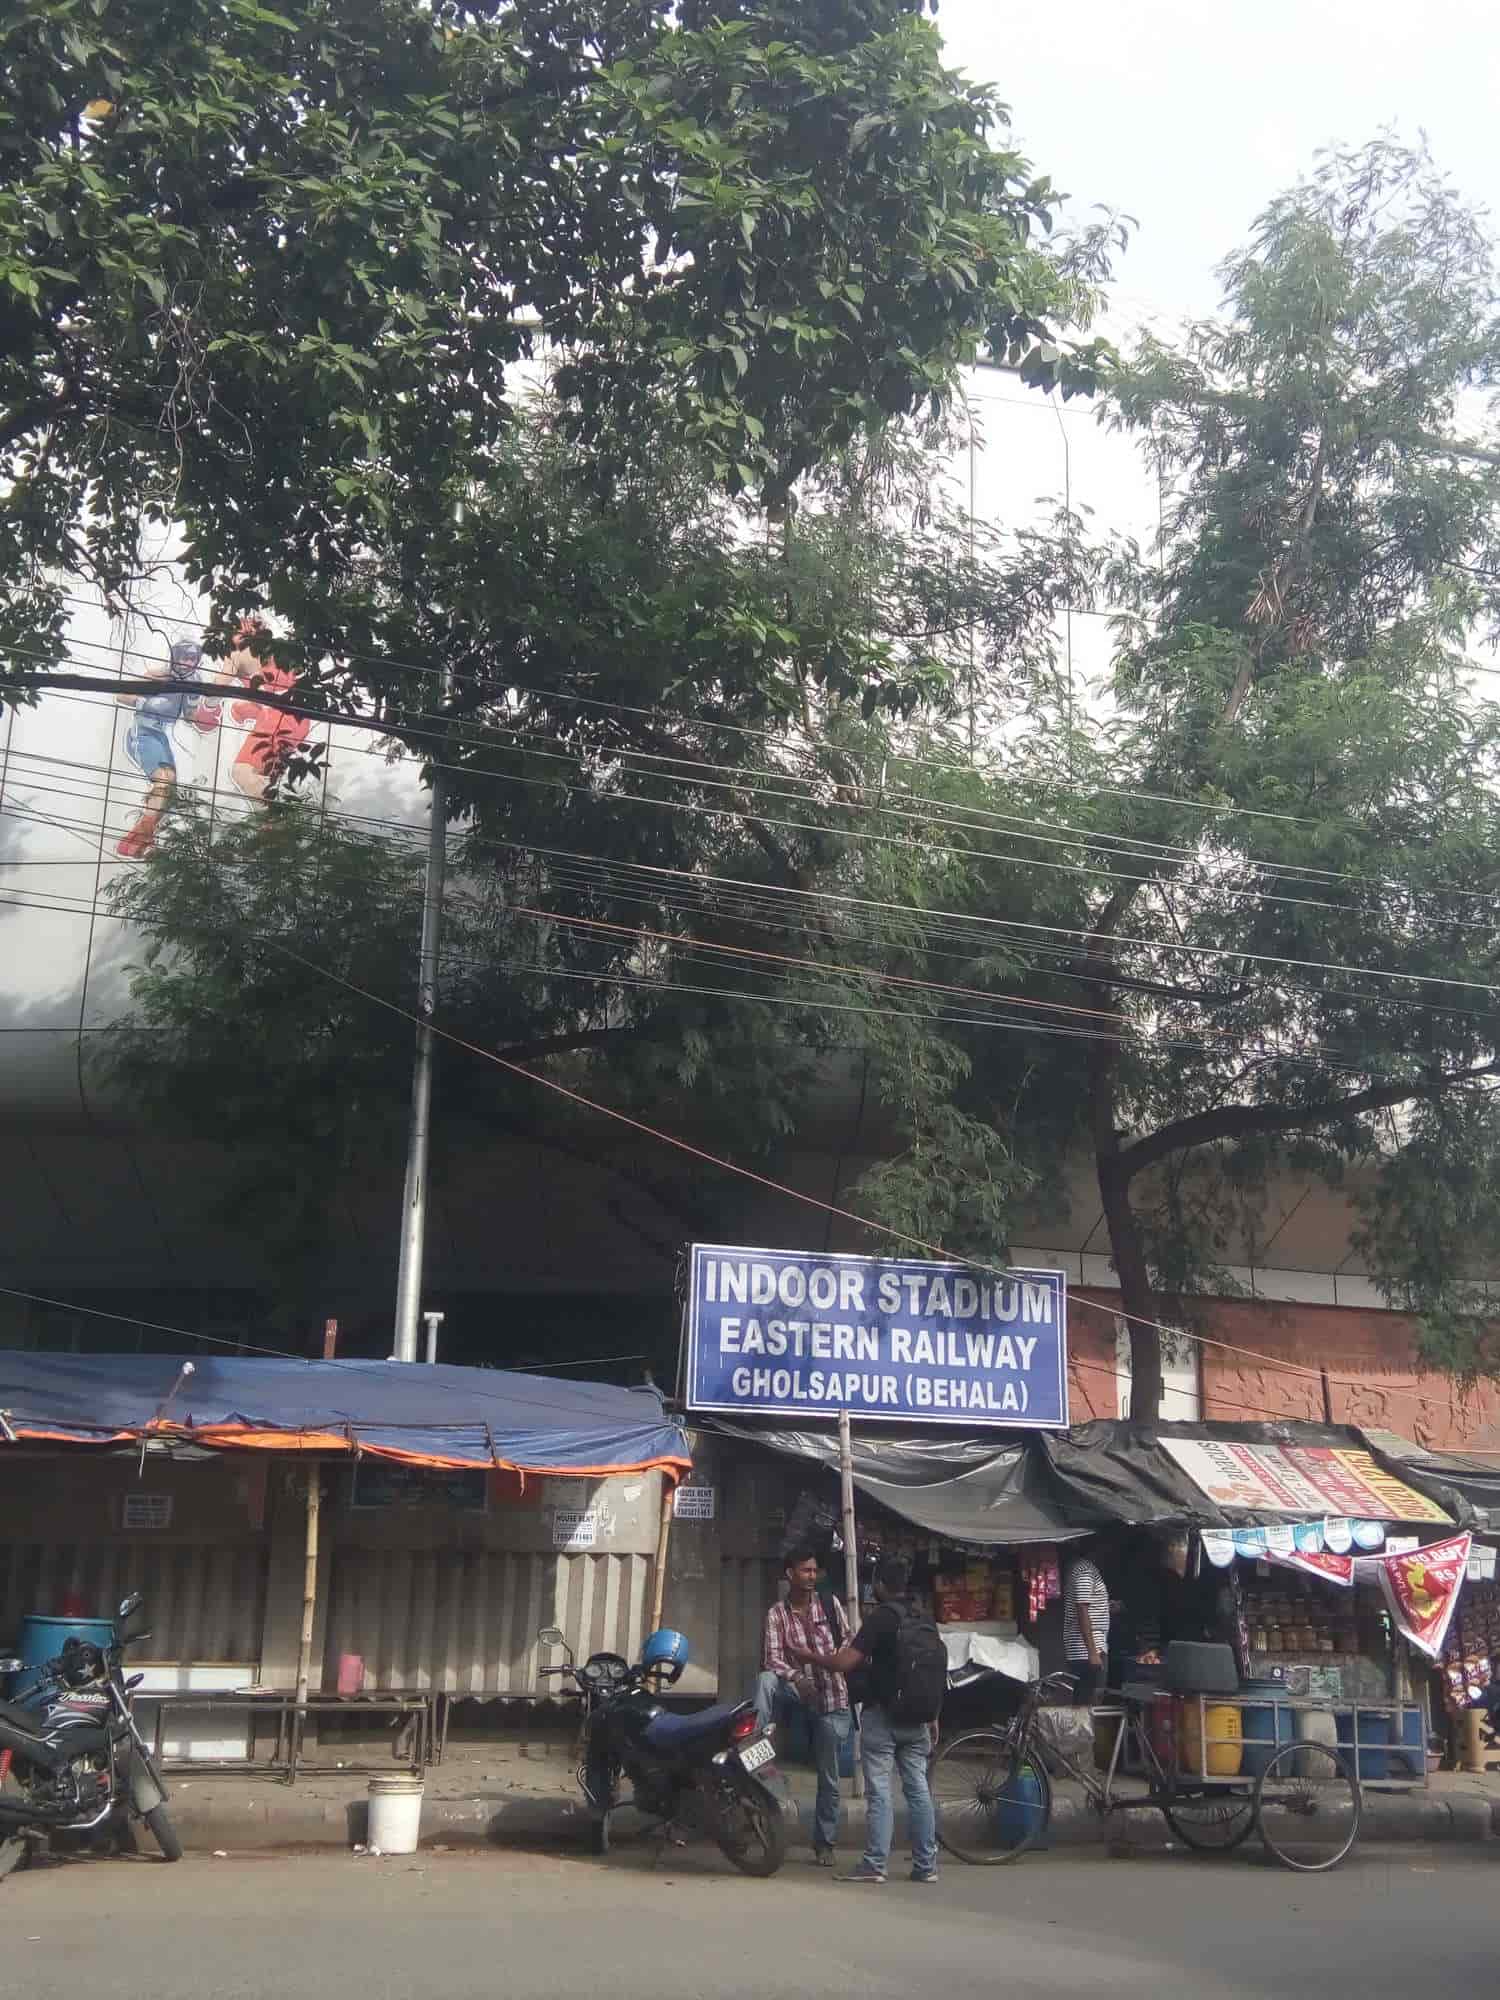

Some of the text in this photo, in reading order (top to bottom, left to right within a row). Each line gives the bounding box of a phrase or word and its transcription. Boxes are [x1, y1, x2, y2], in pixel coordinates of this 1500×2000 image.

[705, 1260, 1052, 1324] INDOOR STADIUM
[719, 1317, 1038, 1371] EASTERN RAILWAY
[732, 1367, 1029, 1413] GHOLSAPUR (BEHALA)
